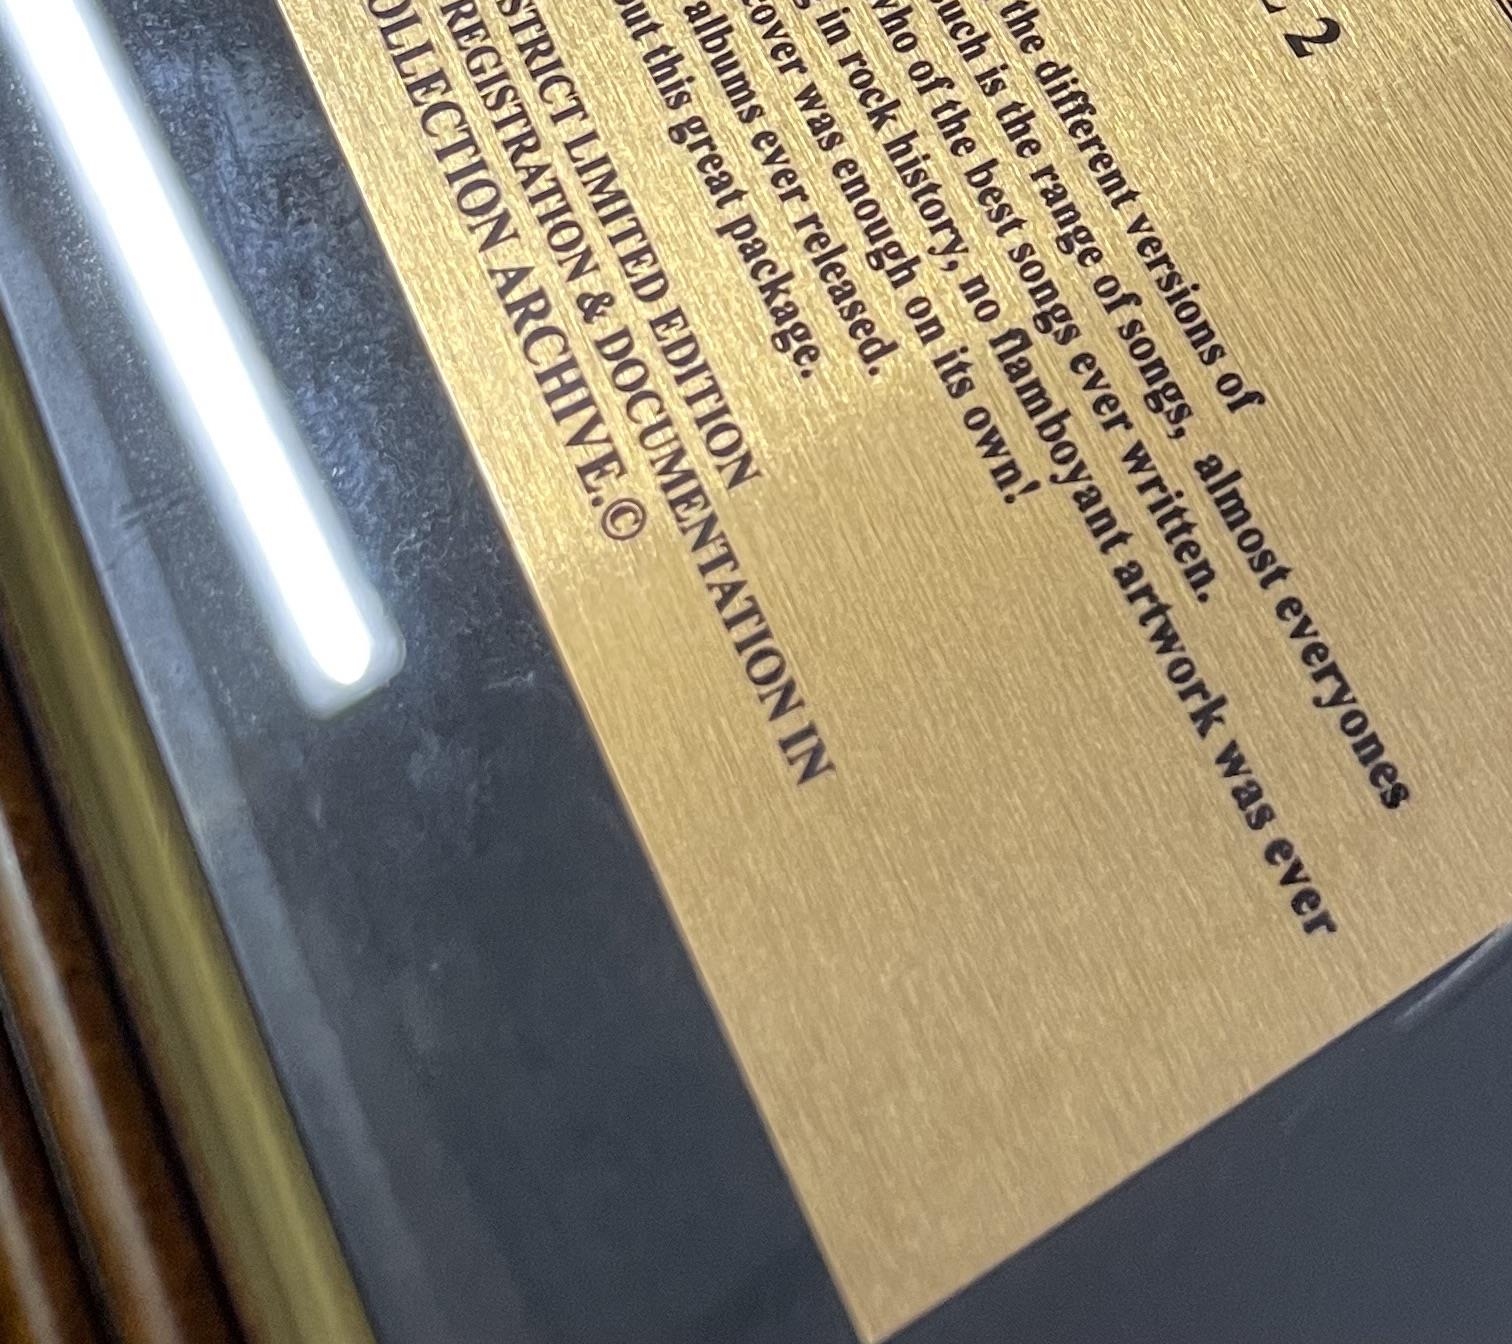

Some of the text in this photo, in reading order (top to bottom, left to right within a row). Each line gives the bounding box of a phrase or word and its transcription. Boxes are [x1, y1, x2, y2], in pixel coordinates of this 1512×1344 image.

[641, 42, 697, 112] this
[666, 114, 749, 211] great
[681, 0, 767, 125] albums
[749, 129, 811, 204] ever
[792, 211, 900, 378] released.
[1282, 15, 1343, 60] 2
[562, 128, 670, 304] LIMITED
[647, 304, 762, 491] EDITION
[574, 291, 616, 325] &
[714, 212, 821, 380] package.
[792, 80, 846, 153] was
[830, 157, 923, 291] enough
[931, 344, 977, 401] its
[962, 404, 1042, 506] own!
[929, 98, 977, 159] the
[962, 156, 1029, 239] best
[1006, 241, 1082, 347] songs
[1068, 350, 1135, 433] ever
[1120, 438, 1217, 605] written.
[1033, 59, 1142, 211] different
[1125, 211, 1228, 368] versions
[592, 325, 806, 723] DOCUMENTATION
[836, 49, 903, 134] rock
[881, 128, 971, 273] history,
[987, 326, 1135, 557] flamboyant
[1111, 558, 1229, 741] artwork
[1213, 737, 1277, 832] was
[1262, 837, 1338, 936] ever
[994, 99, 1043, 160] the
[1028, 162, 1105, 269] range
[1115, 317, 1195, 441] songs,
[1192, 452, 1294, 592] almost
[1274, 595, 1412, 812] everyones
[777, 721, 836, 786] IN
